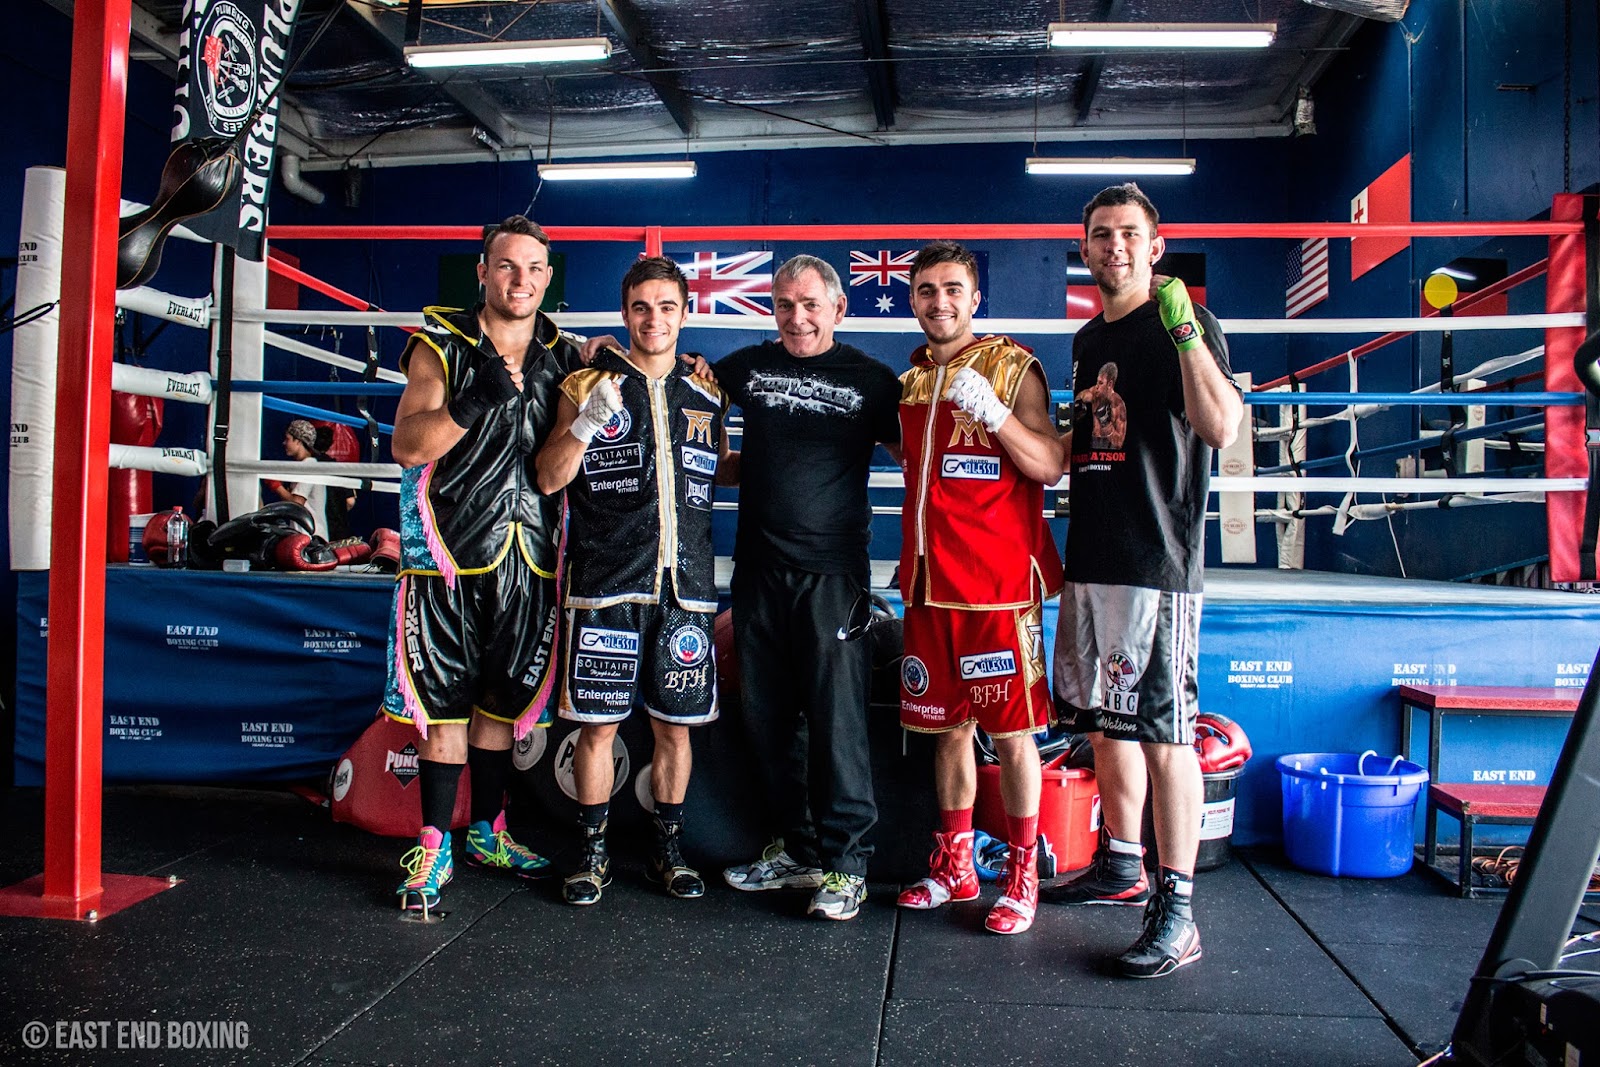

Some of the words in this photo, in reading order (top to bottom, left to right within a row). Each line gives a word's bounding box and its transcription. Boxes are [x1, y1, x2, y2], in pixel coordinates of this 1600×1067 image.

[167, 300, 202, 322] EVERLAST
[166, 377, 200, 397] EVERLAST
[162, 448, 196, 461] EVERLAST
[584, 448, 639, 463] SOLITAIRE
[964, 462, 995, 475] ALESSI
[590, 477, 639, 492] Enterprise
[166, 625, 194, 635] EAST
[195, 626, 219, 636] END
[166, 638, 197, 646] BOXING
[197, 639, 219, 647] CLUB
[303, 640, 336, 649] BOXING
[522, 645, 549, 688] EAST
[542, 605, 557, 644] END
[602, 637, 634, 650] ALESSI
[577, 658, 635, 671] SOLITAIRE
[980, 658, 1010, 673] ALESSI
[1230, 660, 1263, 671] EAST
[1265, 660, 1292, 671] END
[1393, 663, 1427, 674] EAST
[1556, 663, 1590, 674] EAST
[664, 664, 709, 693] BFH
[1227, 674, 1266, 684] BOXING
[1266, 675, 1293, 684] CLUB
[1391, 677, 1430, 686] BOXING
[1554, 677, 1587, 687] BOXIN
[577, 688, 630, 703] Enterprise
[970, 679, 1012, 708] BFH
[901, 700, 946, 715] Enterprise
[110, 715, 136, 725] EAST
[138, 716, 160, 726] END
[109, 728, 140, 736] BOXING
[241, 722, 269, 732] EAST
[271, 723, 293, 733] END
[241, 735, 272, 743] BOXING
[272, 736, 295, 744] CLUB
[385, 750, 420, 773] PUNC
[1472, 769, 1507, 781] EAST
[1508, 769, 1537, 781] END
